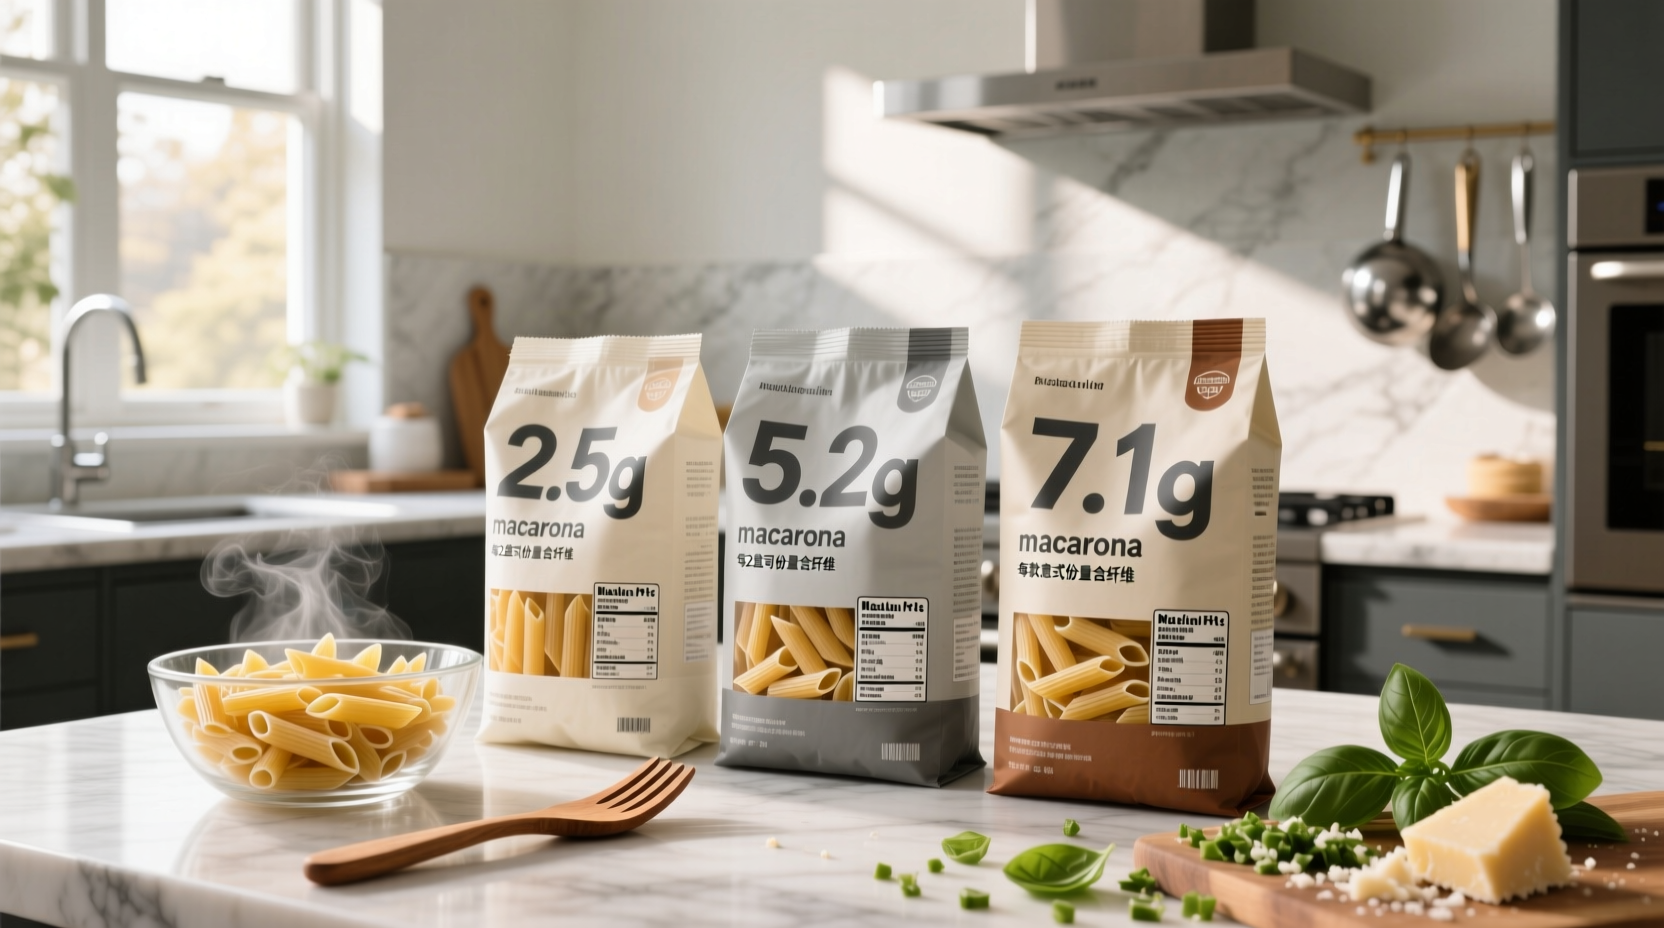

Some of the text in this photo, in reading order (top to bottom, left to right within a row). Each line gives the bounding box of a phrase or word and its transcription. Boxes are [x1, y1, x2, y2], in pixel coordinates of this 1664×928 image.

[497, 423, 647, 520] 2.5g
[742, 419, 919, 530] 5.2g
[1030, 416, 1215, 541] 7.1g
[492, 518, 585, 539] macarona
[738, 526, 846, 548] macarona
[1019, 533, 1142, 558] macarona
